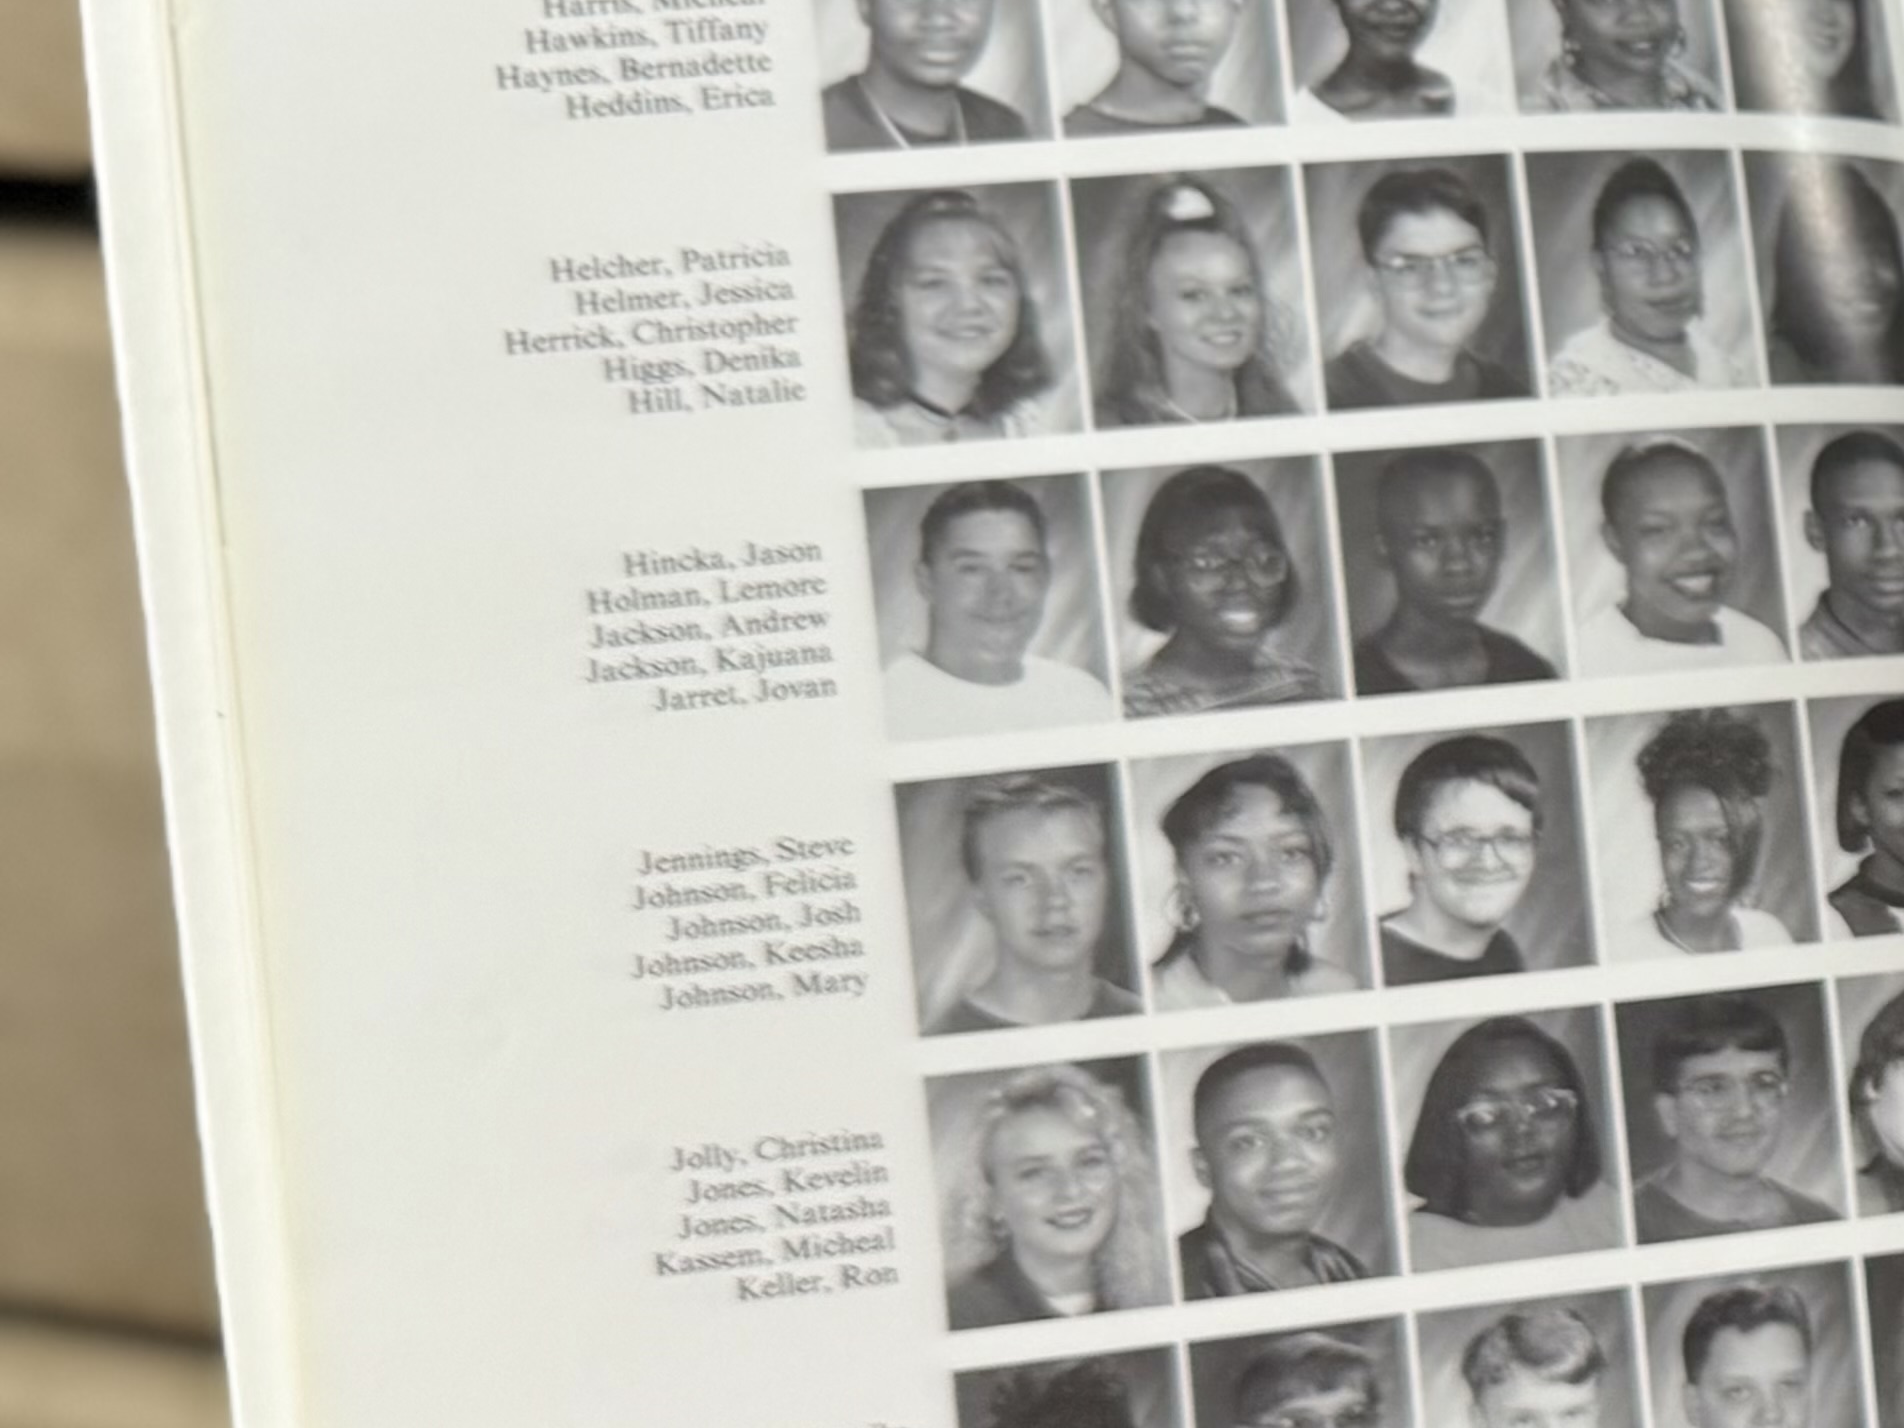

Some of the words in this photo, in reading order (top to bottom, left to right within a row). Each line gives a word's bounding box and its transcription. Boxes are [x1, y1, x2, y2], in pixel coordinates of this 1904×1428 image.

[524, 25, 659, 54] Hawkins,
[664, 16, 769, 45] Tiffany
[496, 63, 611, 92] Haynes,
[619, 49, 773, 82] Bernadette
[701, 82, 776, 111] Erica
[681, 242, 790, 273] Patricia
[574, 288, 691, 316] Helmer,
[699, 277, 795, 307] Jessica
[505, 324, 625, 355] Herrick,
[631, 313, 799, 345] Christopher
[603, 354, 696, 384] Higgs,
[628, 387, 694, 414] Hill,
[699, 377, 806, 408] Natalie
[743, 541, 822, 568] Jason
[586, 586, 711, 615] Holman,
[590, 620, 712, 649] Jackson,
[720, 609, 828, 638] Andrew
[585, 654, 709, 684] Jackson,
[754, 677, 838, 702] Jovan
[637, 845, 770, 876] Jennings,
[776, 835, 854, 862] Steve
[632, 882, 757, 910] Johnson,
[764, 866, 858, 898] Felicia
[666, 913, 792, 941] Johnson,
[799, 900, 861, 928] Josh
[630, 951, 756, 980] Johnson,
[660, 984, 785, 1010] Johnson,
[791, 972, 867, 999] Mary
[670, 1144, 747, 1173] Jolly,
[754, 1130, 884, 1161] Christina
[686, 1179, 775, 1205] Jones,
[678, 1214, 766, 1240] Jones,
[773, 1196, 891, 1228] Natasha
[737, 1272, 833, 1301] Keller,
[841, 1264, 898, 1288] Ron
